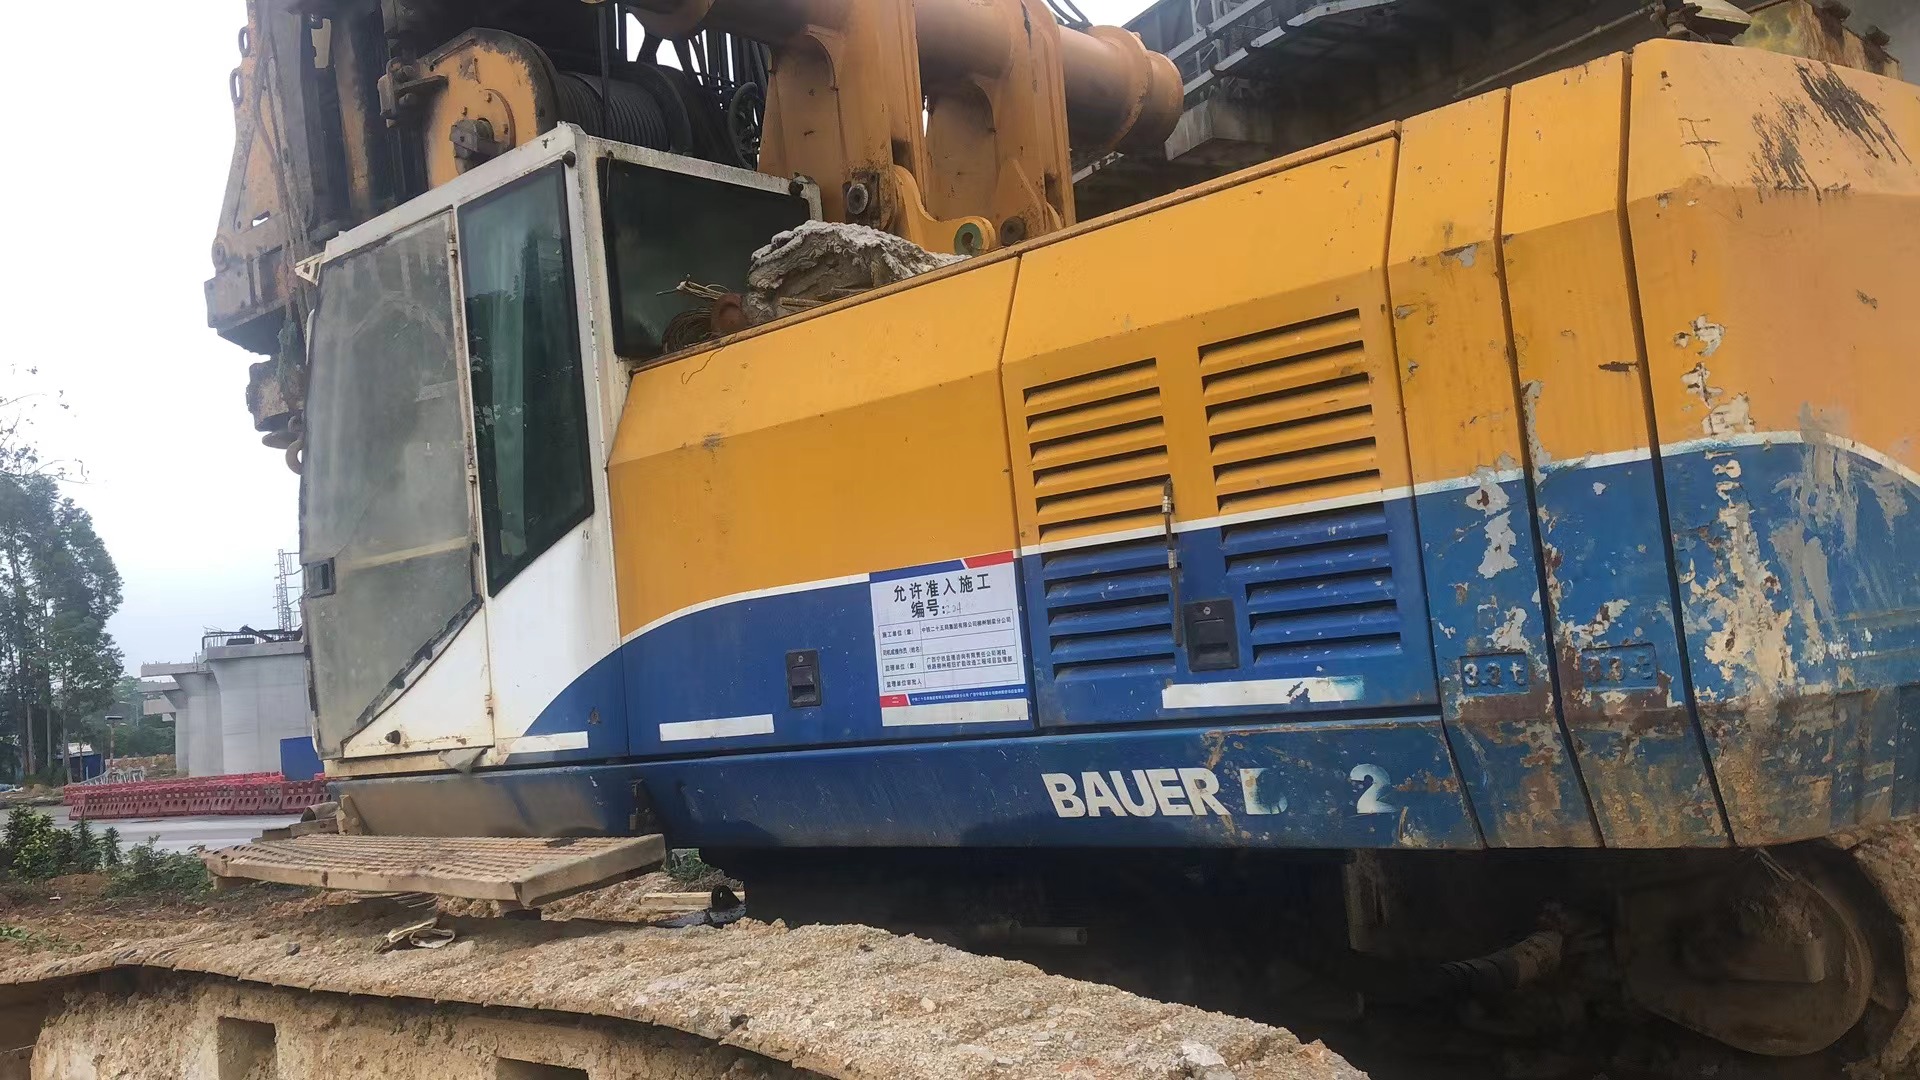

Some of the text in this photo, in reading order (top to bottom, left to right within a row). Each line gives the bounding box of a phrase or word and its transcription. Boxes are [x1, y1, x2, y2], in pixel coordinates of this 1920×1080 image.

[893, 573, 991, 603] 允许准入施工
[911, 599, 946, 618] 编号:
[1041, 767, 1233, 818] BAUER
